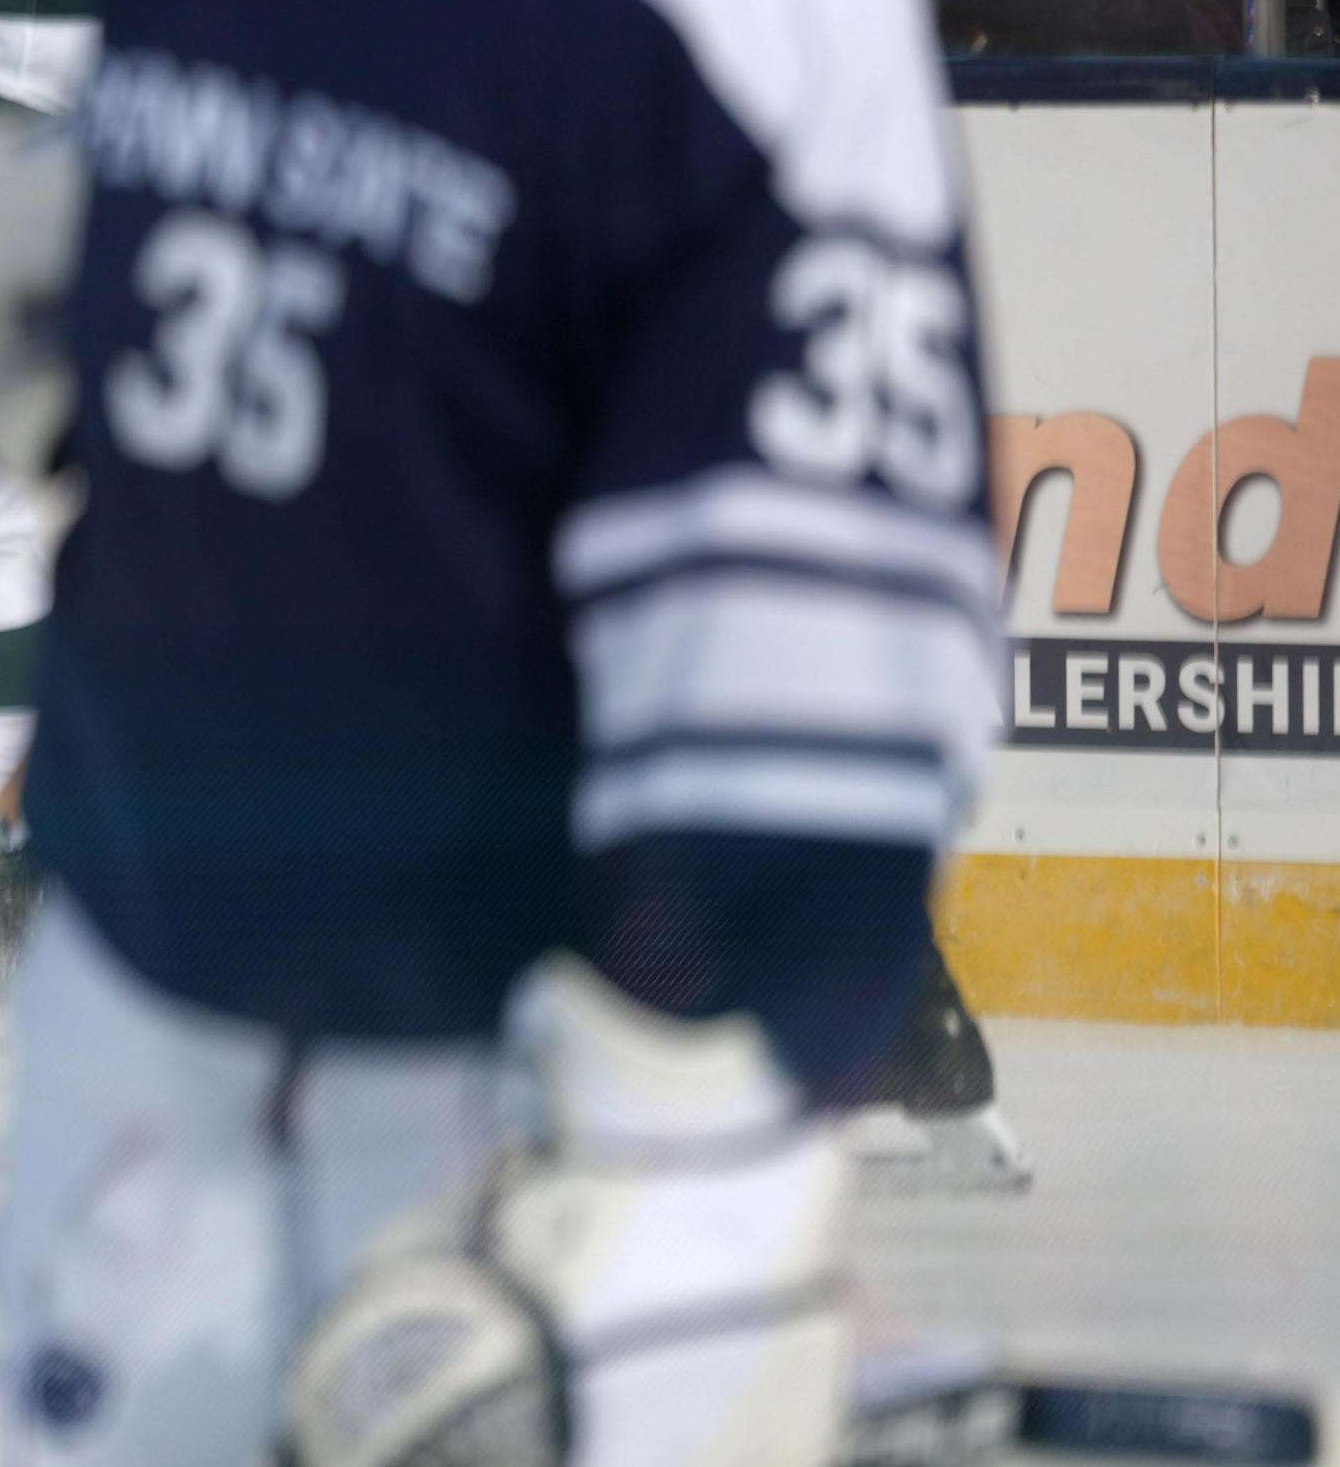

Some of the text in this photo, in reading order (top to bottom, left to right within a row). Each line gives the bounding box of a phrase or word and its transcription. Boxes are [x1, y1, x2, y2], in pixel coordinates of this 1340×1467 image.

[104, 201, 349, 505] 35
[747, 233, 981, 509] 35
[991, 649, 1340, 737] LERSHI
